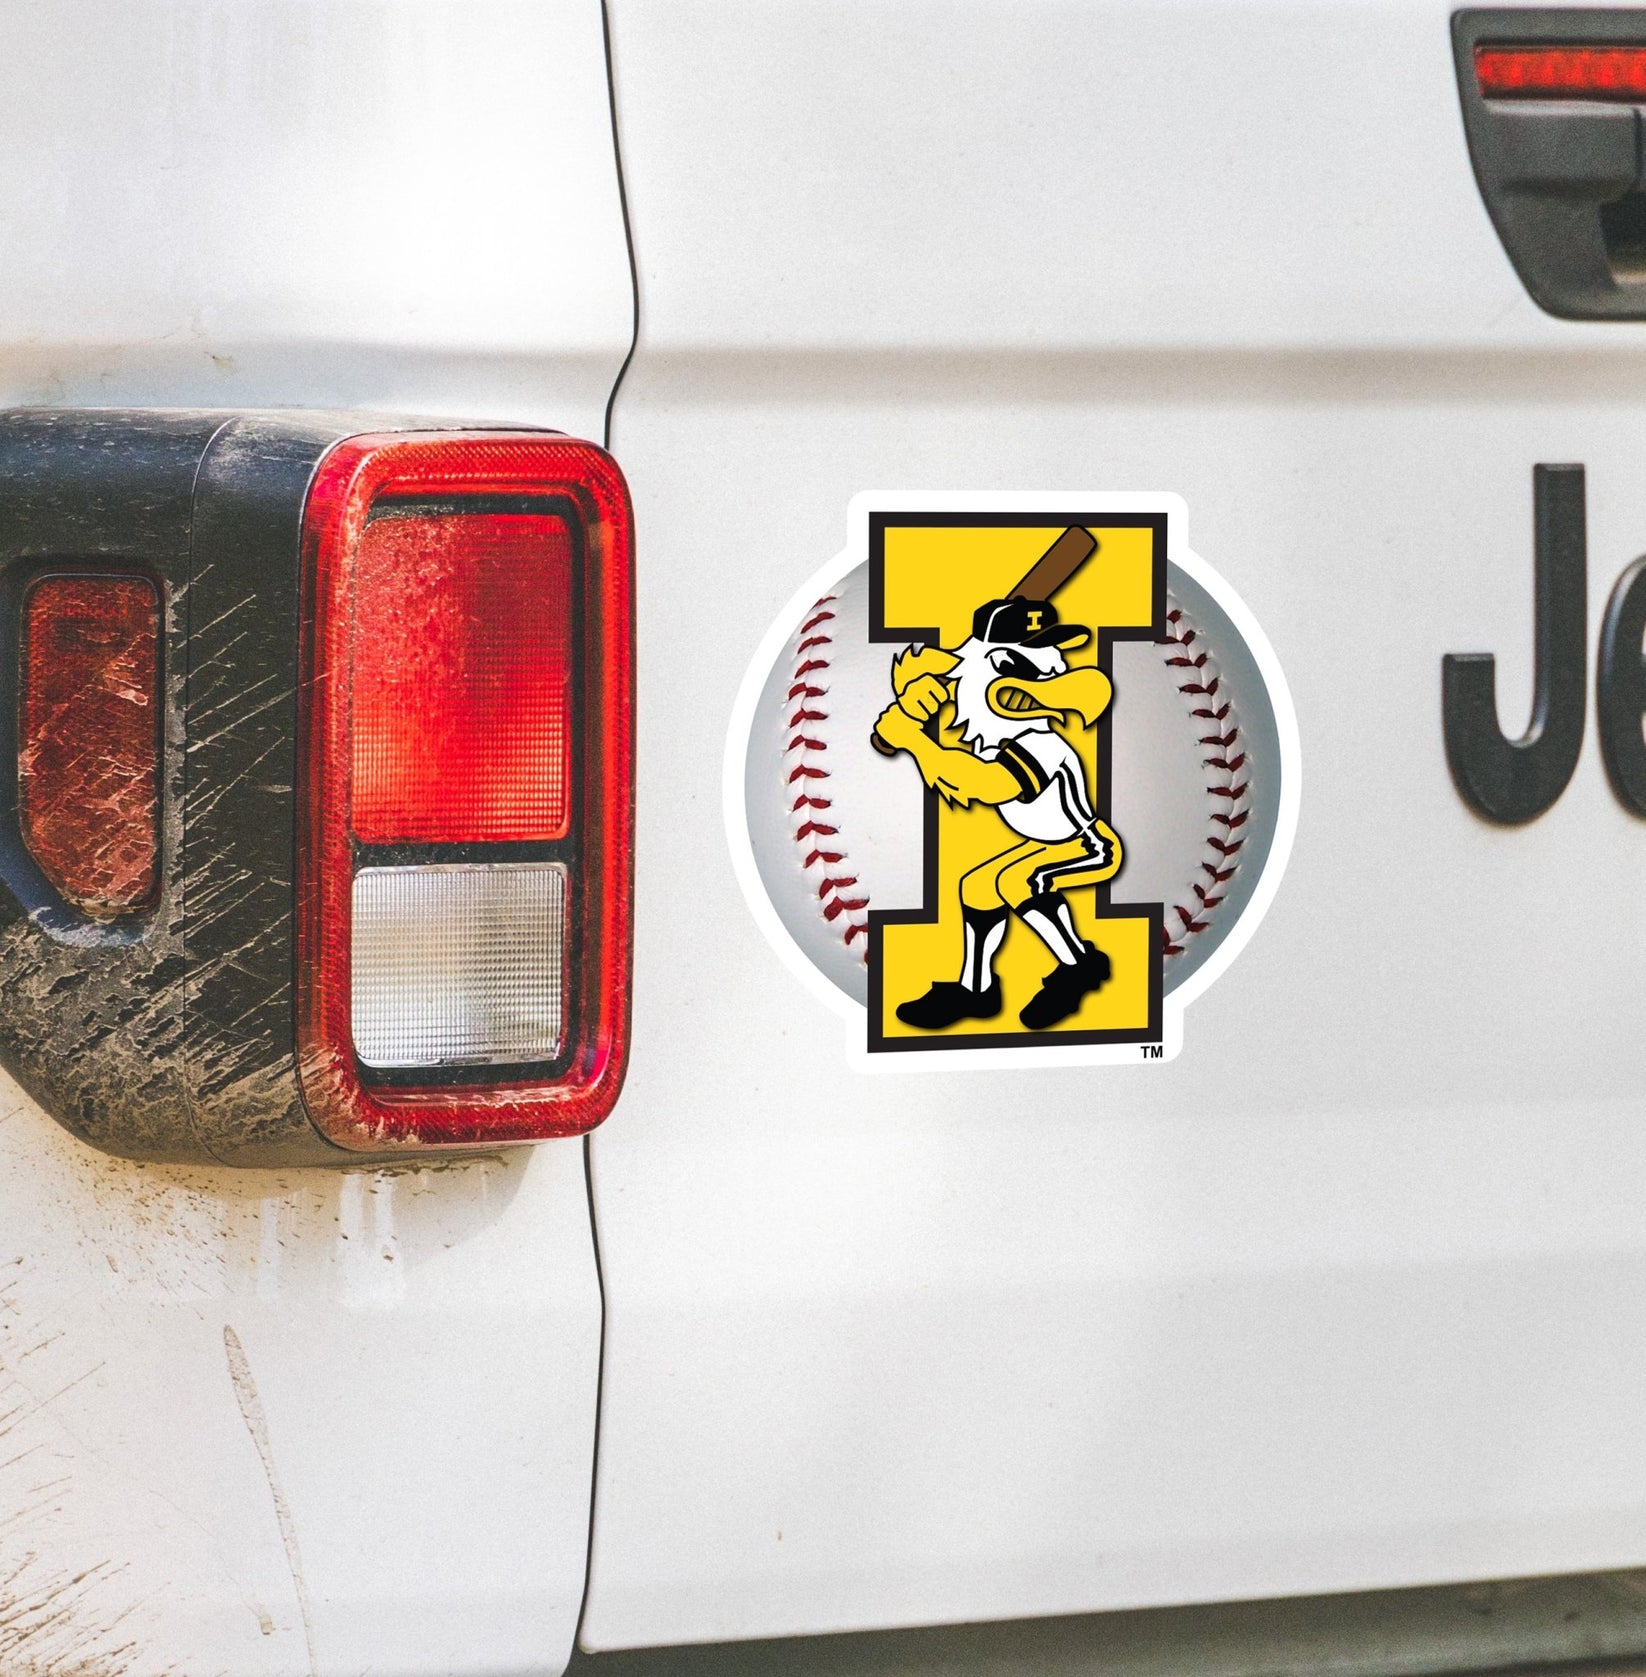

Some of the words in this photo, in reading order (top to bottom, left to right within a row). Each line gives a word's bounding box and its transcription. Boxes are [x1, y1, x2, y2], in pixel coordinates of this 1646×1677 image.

[1027, 611, 1042, 631] I
[867, 511, 1168, 1053] I
[1140, 1045, 1163, 1059] TM
